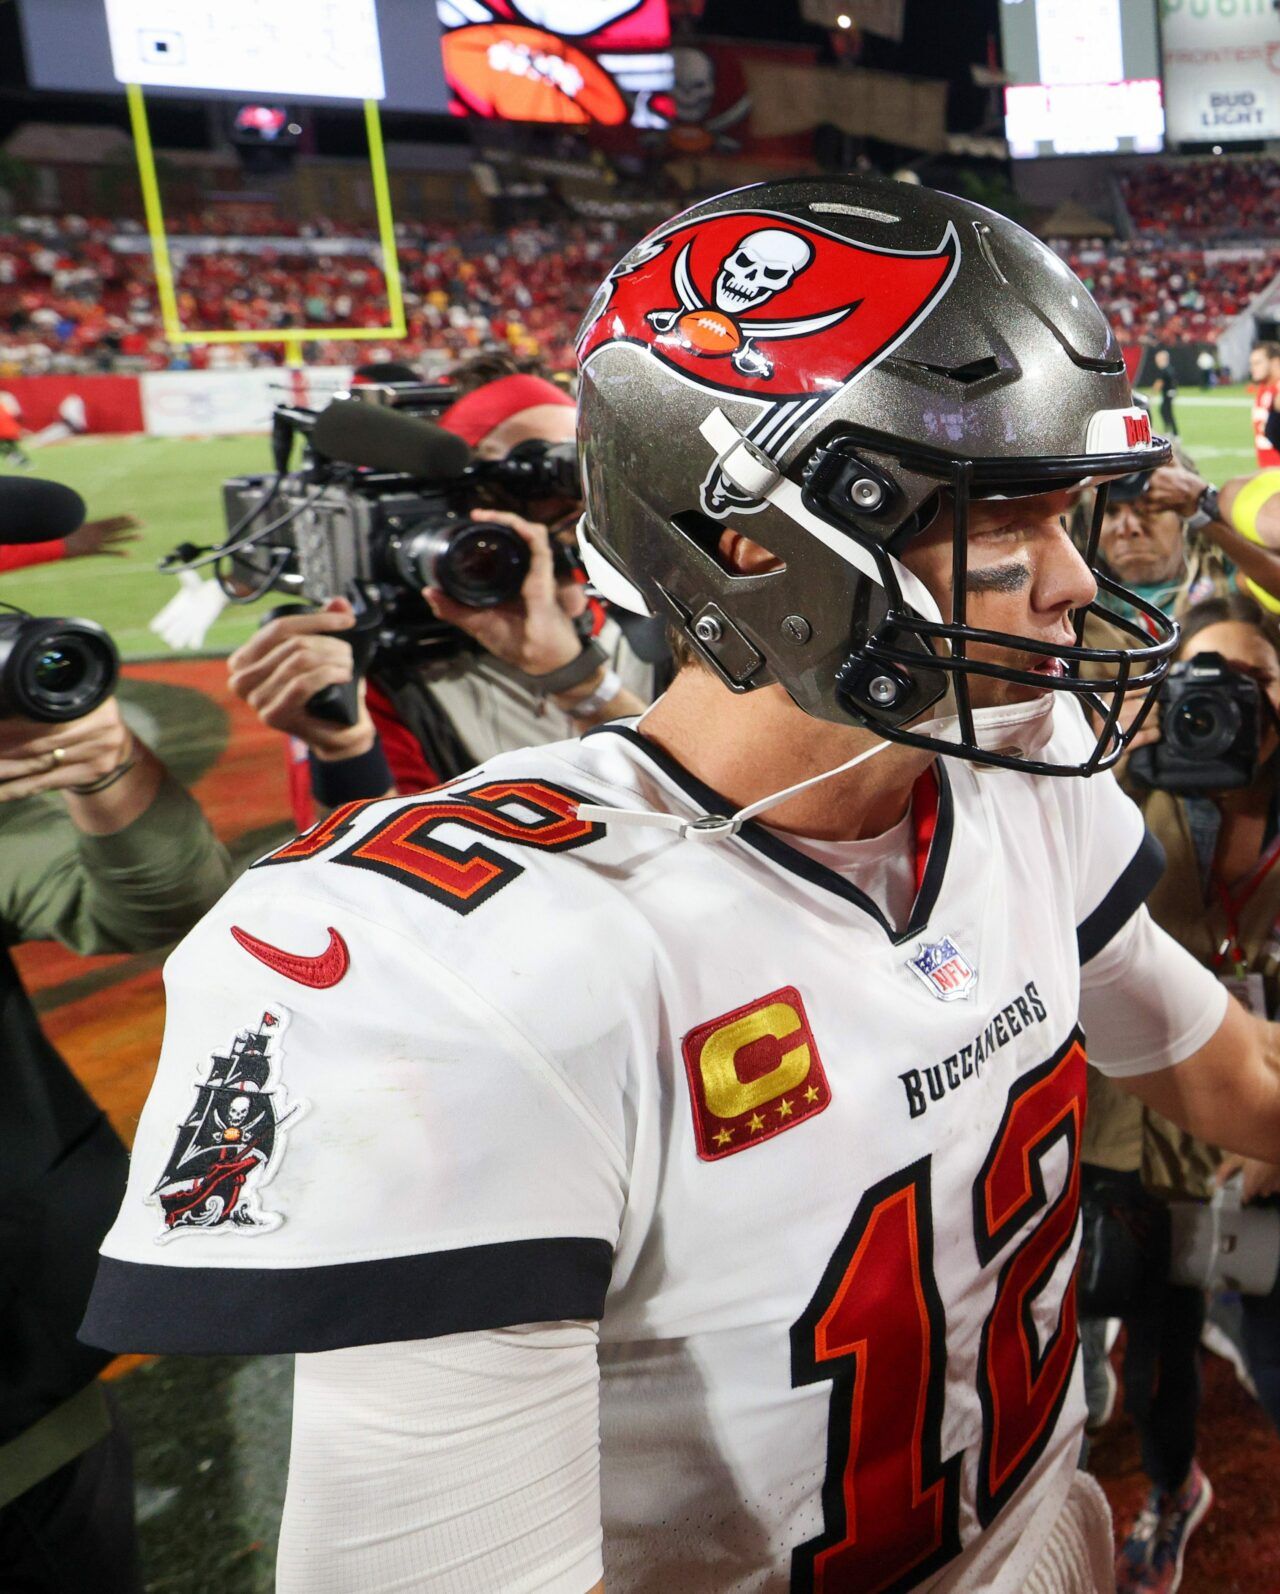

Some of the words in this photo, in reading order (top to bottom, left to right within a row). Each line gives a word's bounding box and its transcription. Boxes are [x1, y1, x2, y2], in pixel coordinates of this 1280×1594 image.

[1201, 108, 1264, 127] LIGHT
[1210, 92, 1256, 107] BUD
[931, 959, 970, 991] NFL
[699, 1002, 811, 1119] C
[897, 980, 1048, 1119] BUCCANEERS
[788, 1021, 1088, 1594] 12
